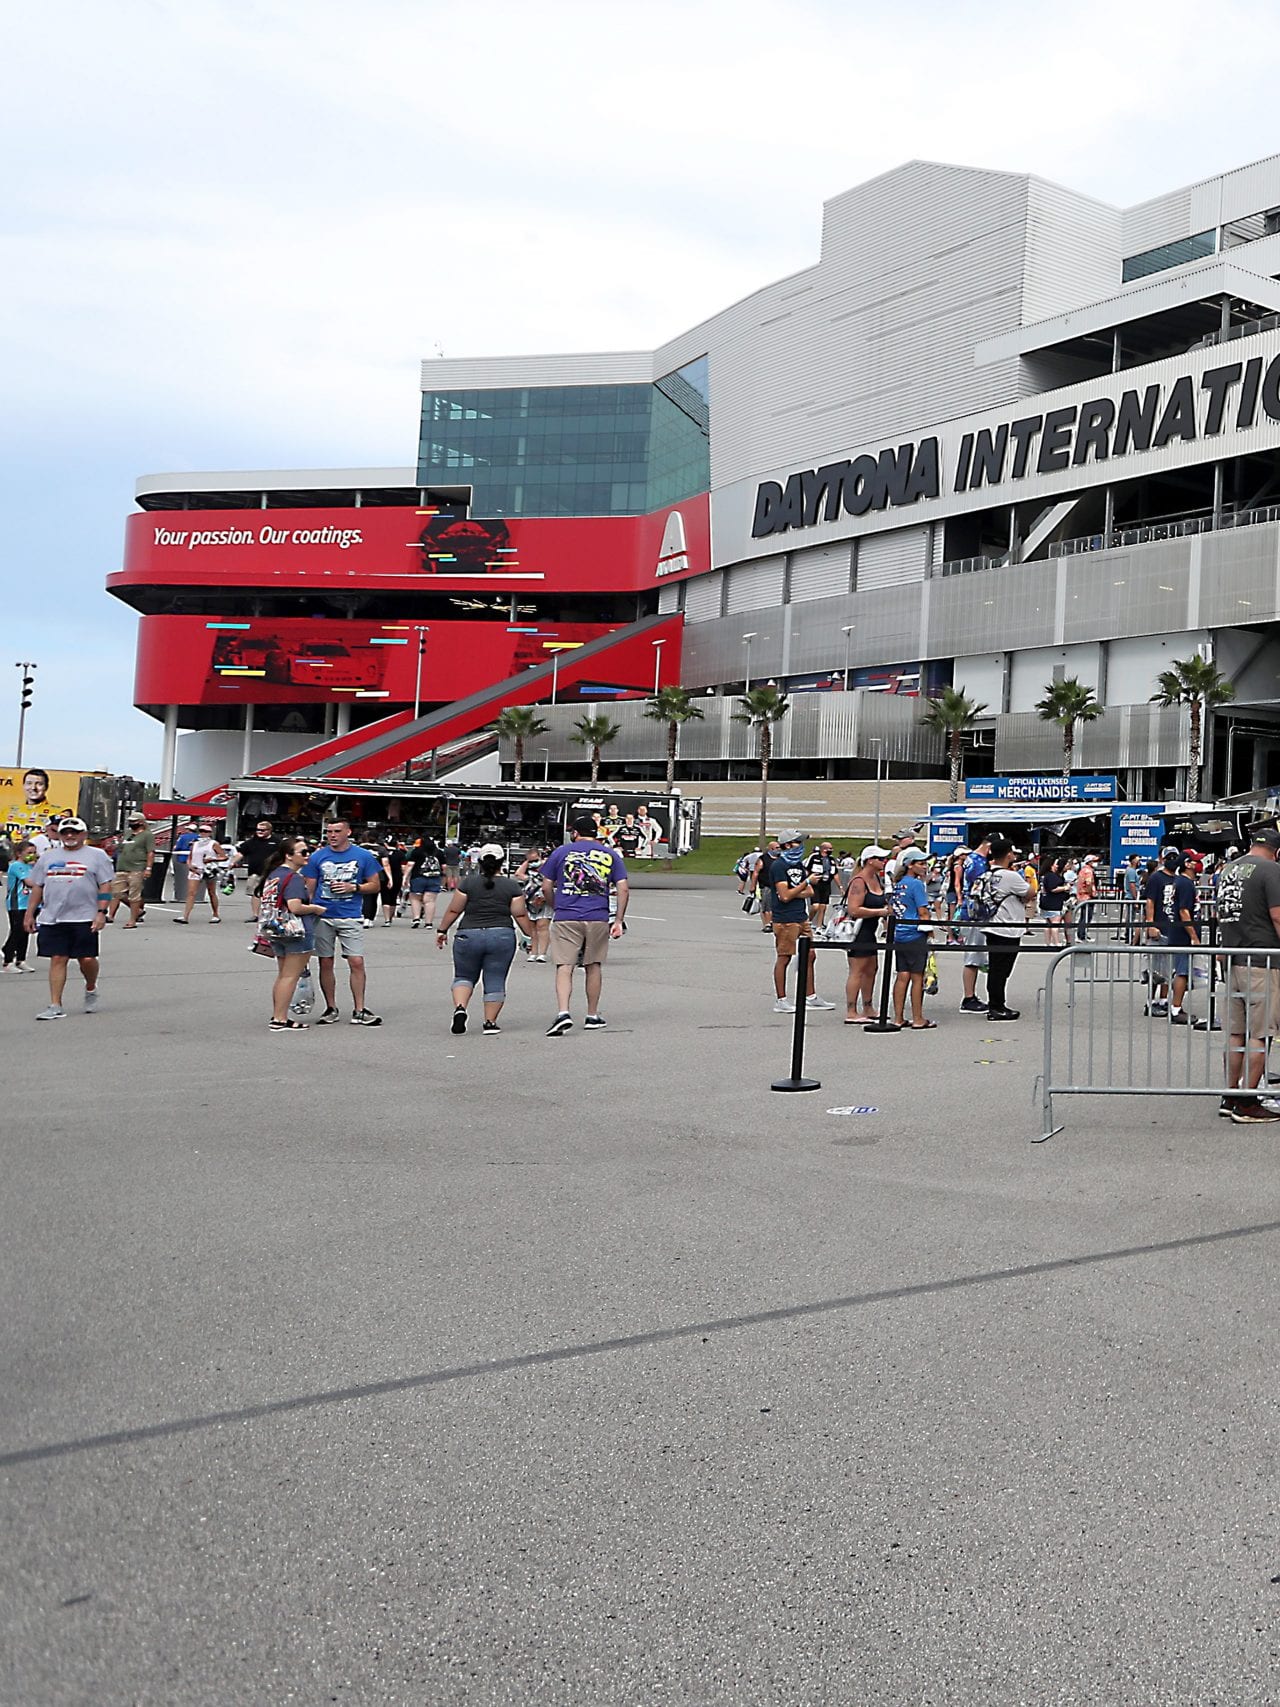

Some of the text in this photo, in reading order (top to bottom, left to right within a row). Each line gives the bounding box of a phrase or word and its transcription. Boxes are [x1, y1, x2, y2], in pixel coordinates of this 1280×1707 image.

[751, 436, 940, 538] DAYTONA
[154, 526, 364, 549] Your passion. Our coatings.
[998, 786, 1078, 798] MERCHANDISE
